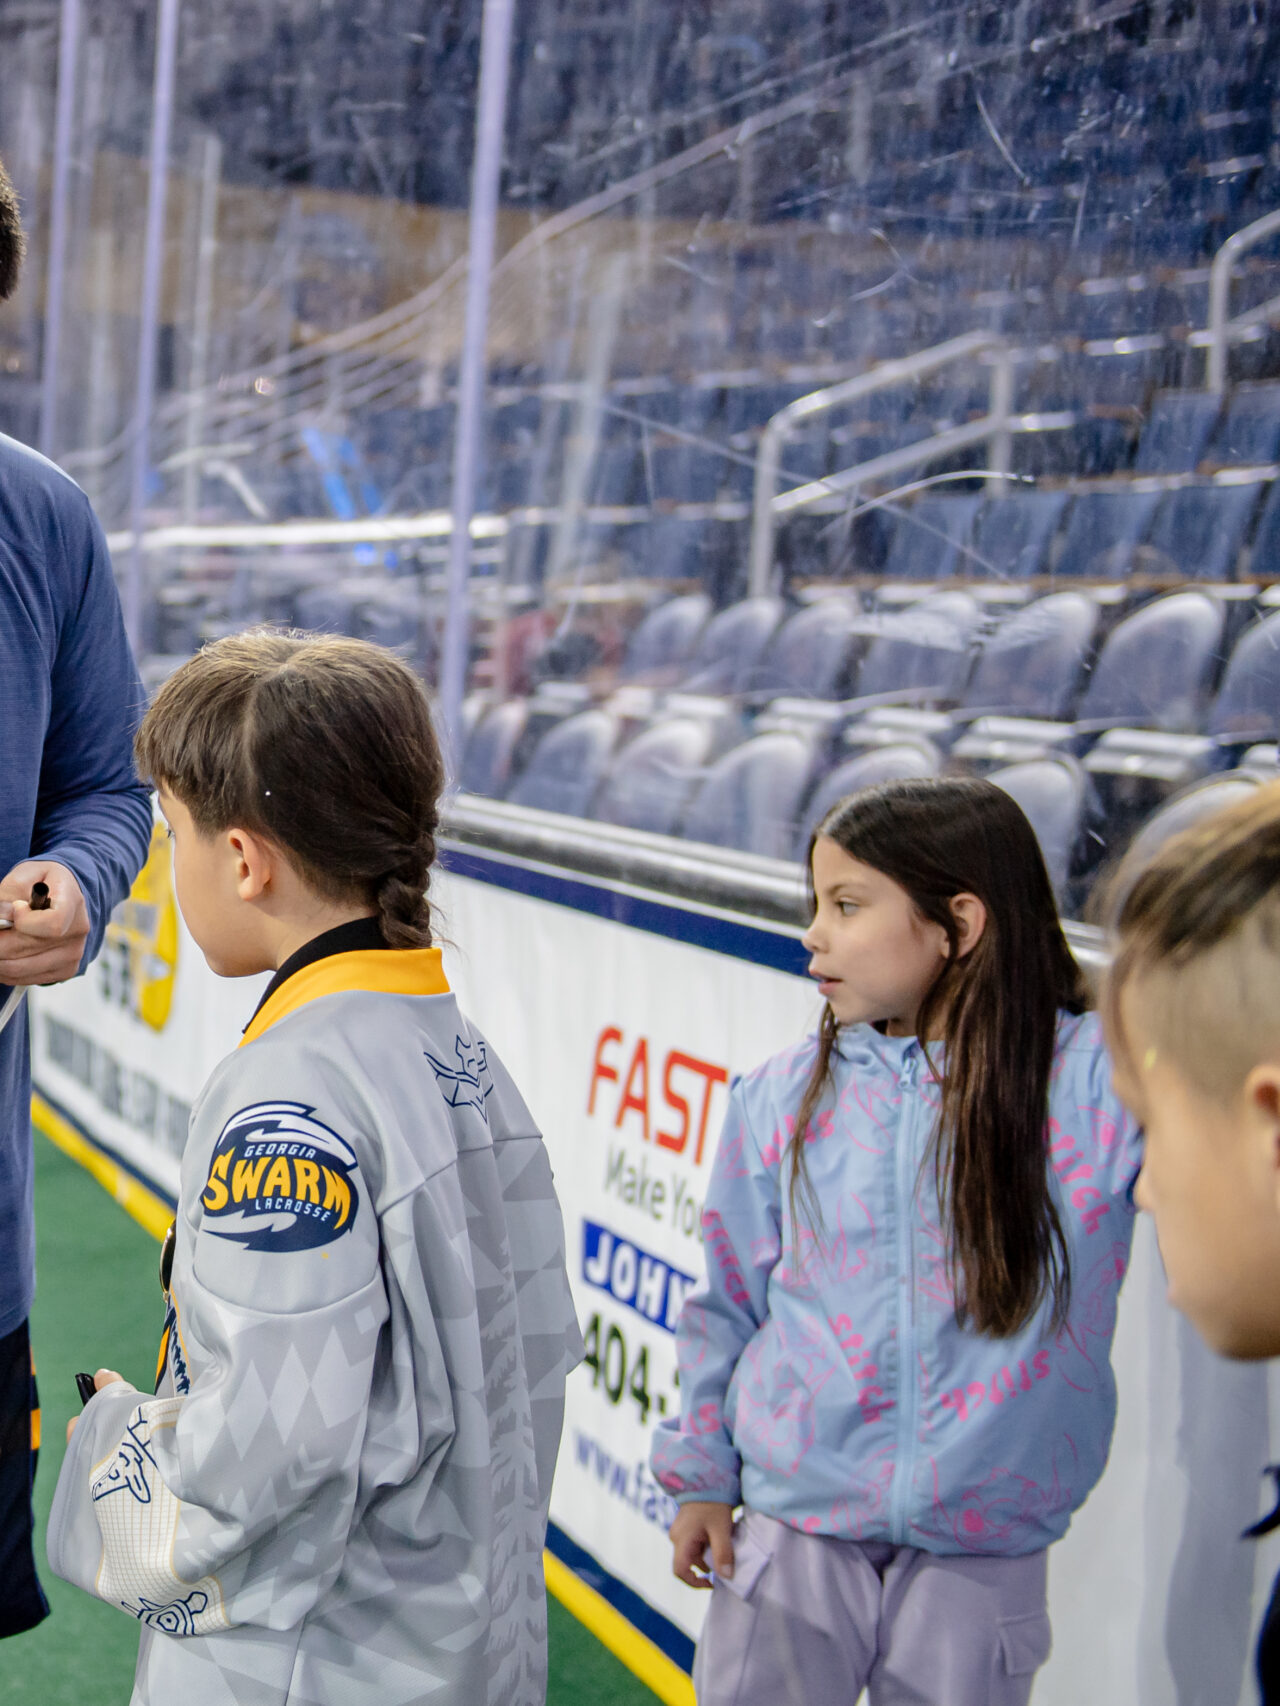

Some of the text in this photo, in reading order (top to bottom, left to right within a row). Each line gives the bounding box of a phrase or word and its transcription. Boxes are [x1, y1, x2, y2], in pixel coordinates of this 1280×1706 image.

[587, 1025, 730, 1167] FAST
[204, 1146, 351, 1230] SWARM
[244, 1143, 317, 1159] GEORGIA
[605, 1146, 666, 1222] Make
[255, 1198, 331, 1222] LACROSSE
[583, 1311, 681, 1427] 404-
[827, 1313, 897, 1425] stitch
[939, 1349, 1051, 1422] stitch
